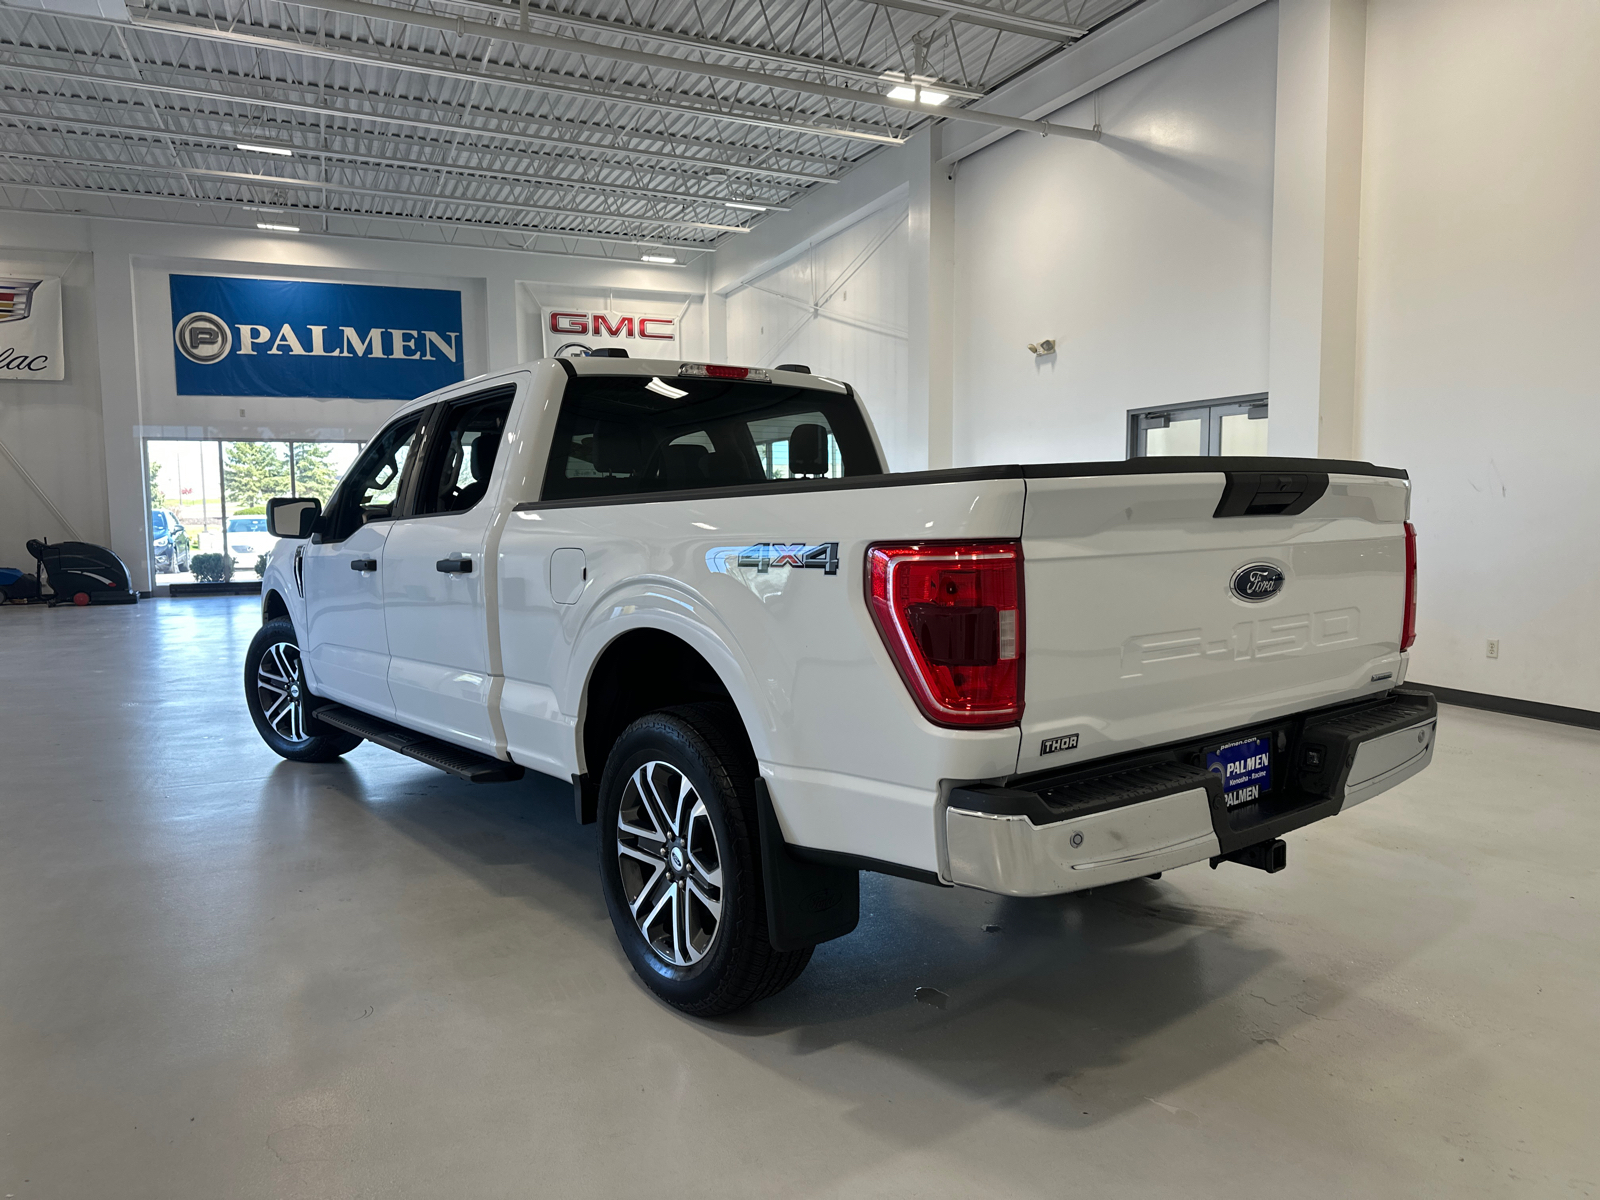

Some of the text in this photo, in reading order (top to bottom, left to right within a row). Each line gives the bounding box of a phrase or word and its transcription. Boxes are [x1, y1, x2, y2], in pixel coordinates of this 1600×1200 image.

[549, 310, 675, 341] GMC
[234, 323, 460, 363] PALMEN
[1246, 571, 1276, 594] Ford
[1120, 606, 1360, 679] F-150
[1044, 736, 1078, 753] THOR
[1220, 737, 1257, 750] palmen.com
[1226, 752, 1269, 777] PALMEN
[1229, 776, 1249, 786] Kenosha
[1251, 771, 1267, 779] Racine
